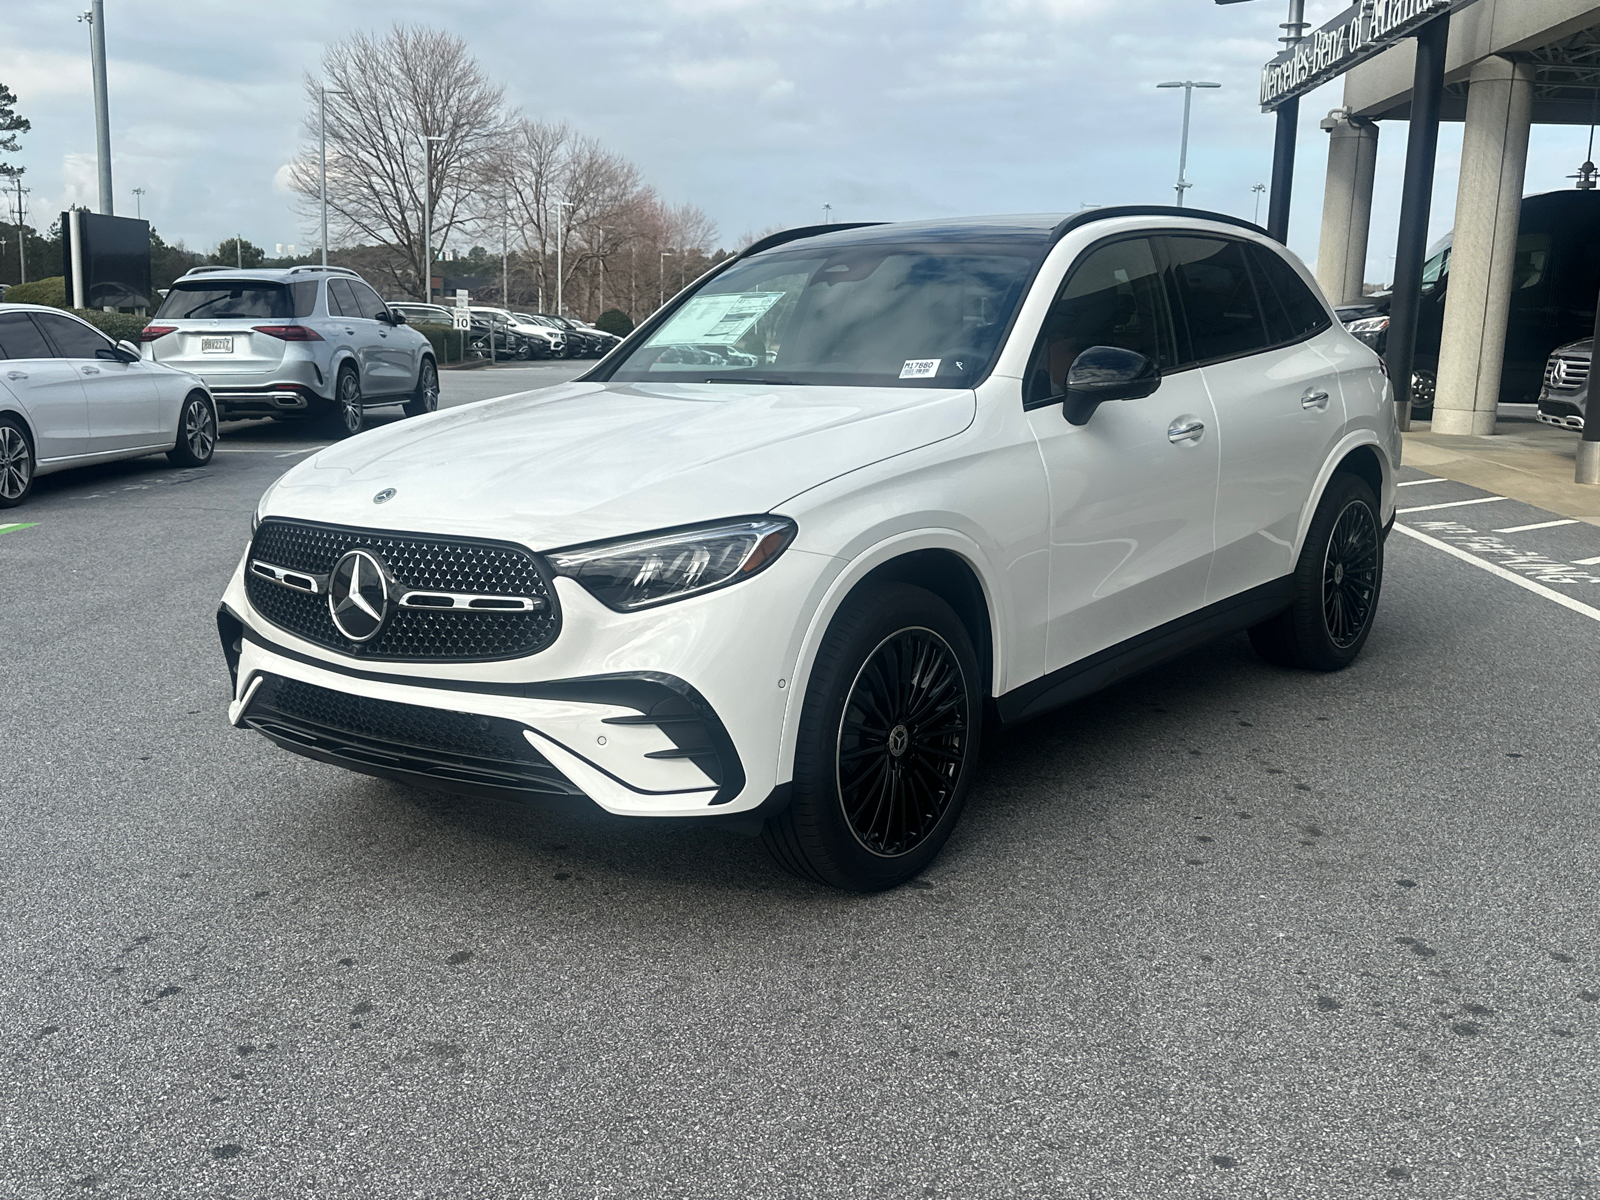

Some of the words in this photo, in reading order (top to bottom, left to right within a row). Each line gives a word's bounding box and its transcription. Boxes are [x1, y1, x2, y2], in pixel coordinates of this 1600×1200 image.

[1261, 24, 1346, 103] Mercedes-Benz
[1349, 0, 1367, 53] of
[1366, 0, 1434, 42] Atlan
[456, 318, 468, 328] 10
